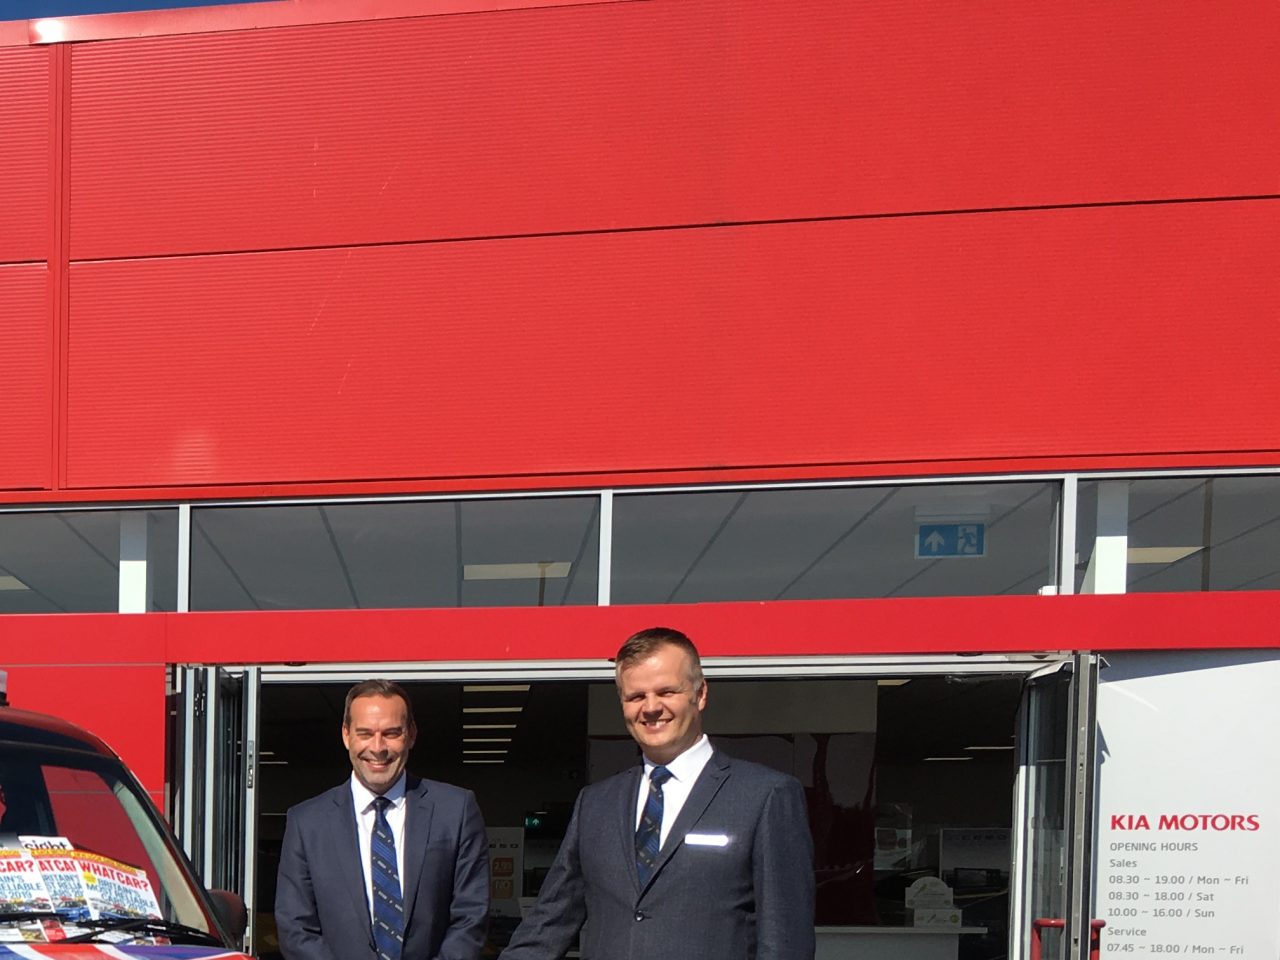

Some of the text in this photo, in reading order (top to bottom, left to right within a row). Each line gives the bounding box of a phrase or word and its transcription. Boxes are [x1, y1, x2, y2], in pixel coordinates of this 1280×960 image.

[1110, 814, 1260, 832] KIA MOTORS
[1110, 842, 1199, 852] OPENING HOURS
[1109, 859, 1137, 868] Sales
[1109, 875, 1140, 884] 08.30
[1155, 875, 1185, 885] 19.00
[1197, 876, 1220, 885] Mon
[1235, 876, 1249, 885] Fri
[1108, 891, 1139, 901] 08.30
[1154, 892, 1185, 901] 18.00
[1196, 892, 1214, 901] Sat
[1107, 908, 1137, 917] 10.00
[1153, 908, 1183, 918] 16.00
[1194, 909, 1215, 918] Sun
[1107, 927, 1147, 936] Service
[1107, 943, 1135, 952] 07.45
[1150, 944, 1180, 953] 18.00
[1192, 944, 1215, 954] Mon
[1230, 945, 1244, 954] Fri
